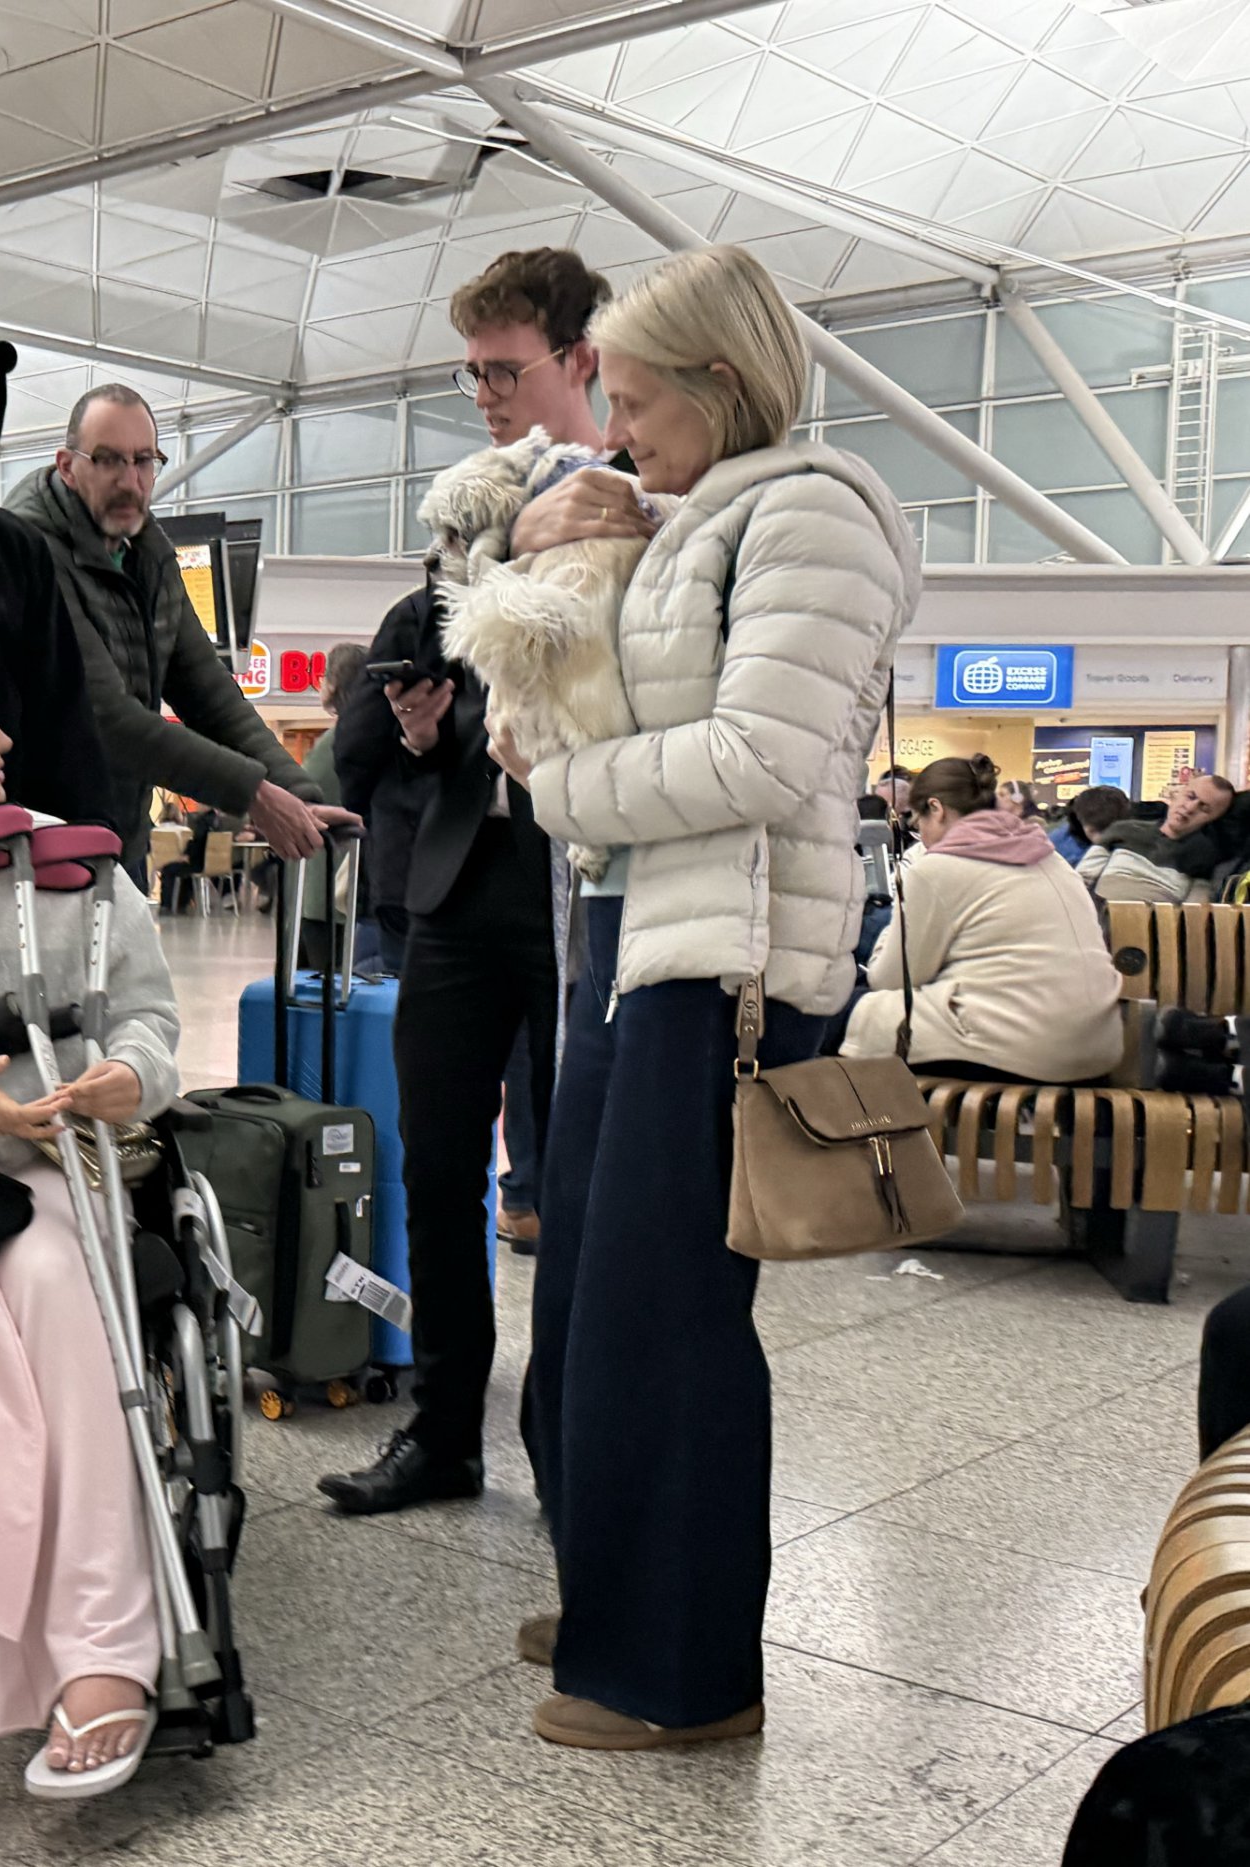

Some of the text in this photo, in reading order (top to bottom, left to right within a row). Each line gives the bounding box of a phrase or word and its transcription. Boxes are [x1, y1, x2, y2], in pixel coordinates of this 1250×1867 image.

[1006, 667, 1047, 675] EXCESS
[1086, 673, 1150, 682] Travel Goods
[1173, 673, 1213, 684] Delivery
[1006, 683, 1046, 691] COMPANY
